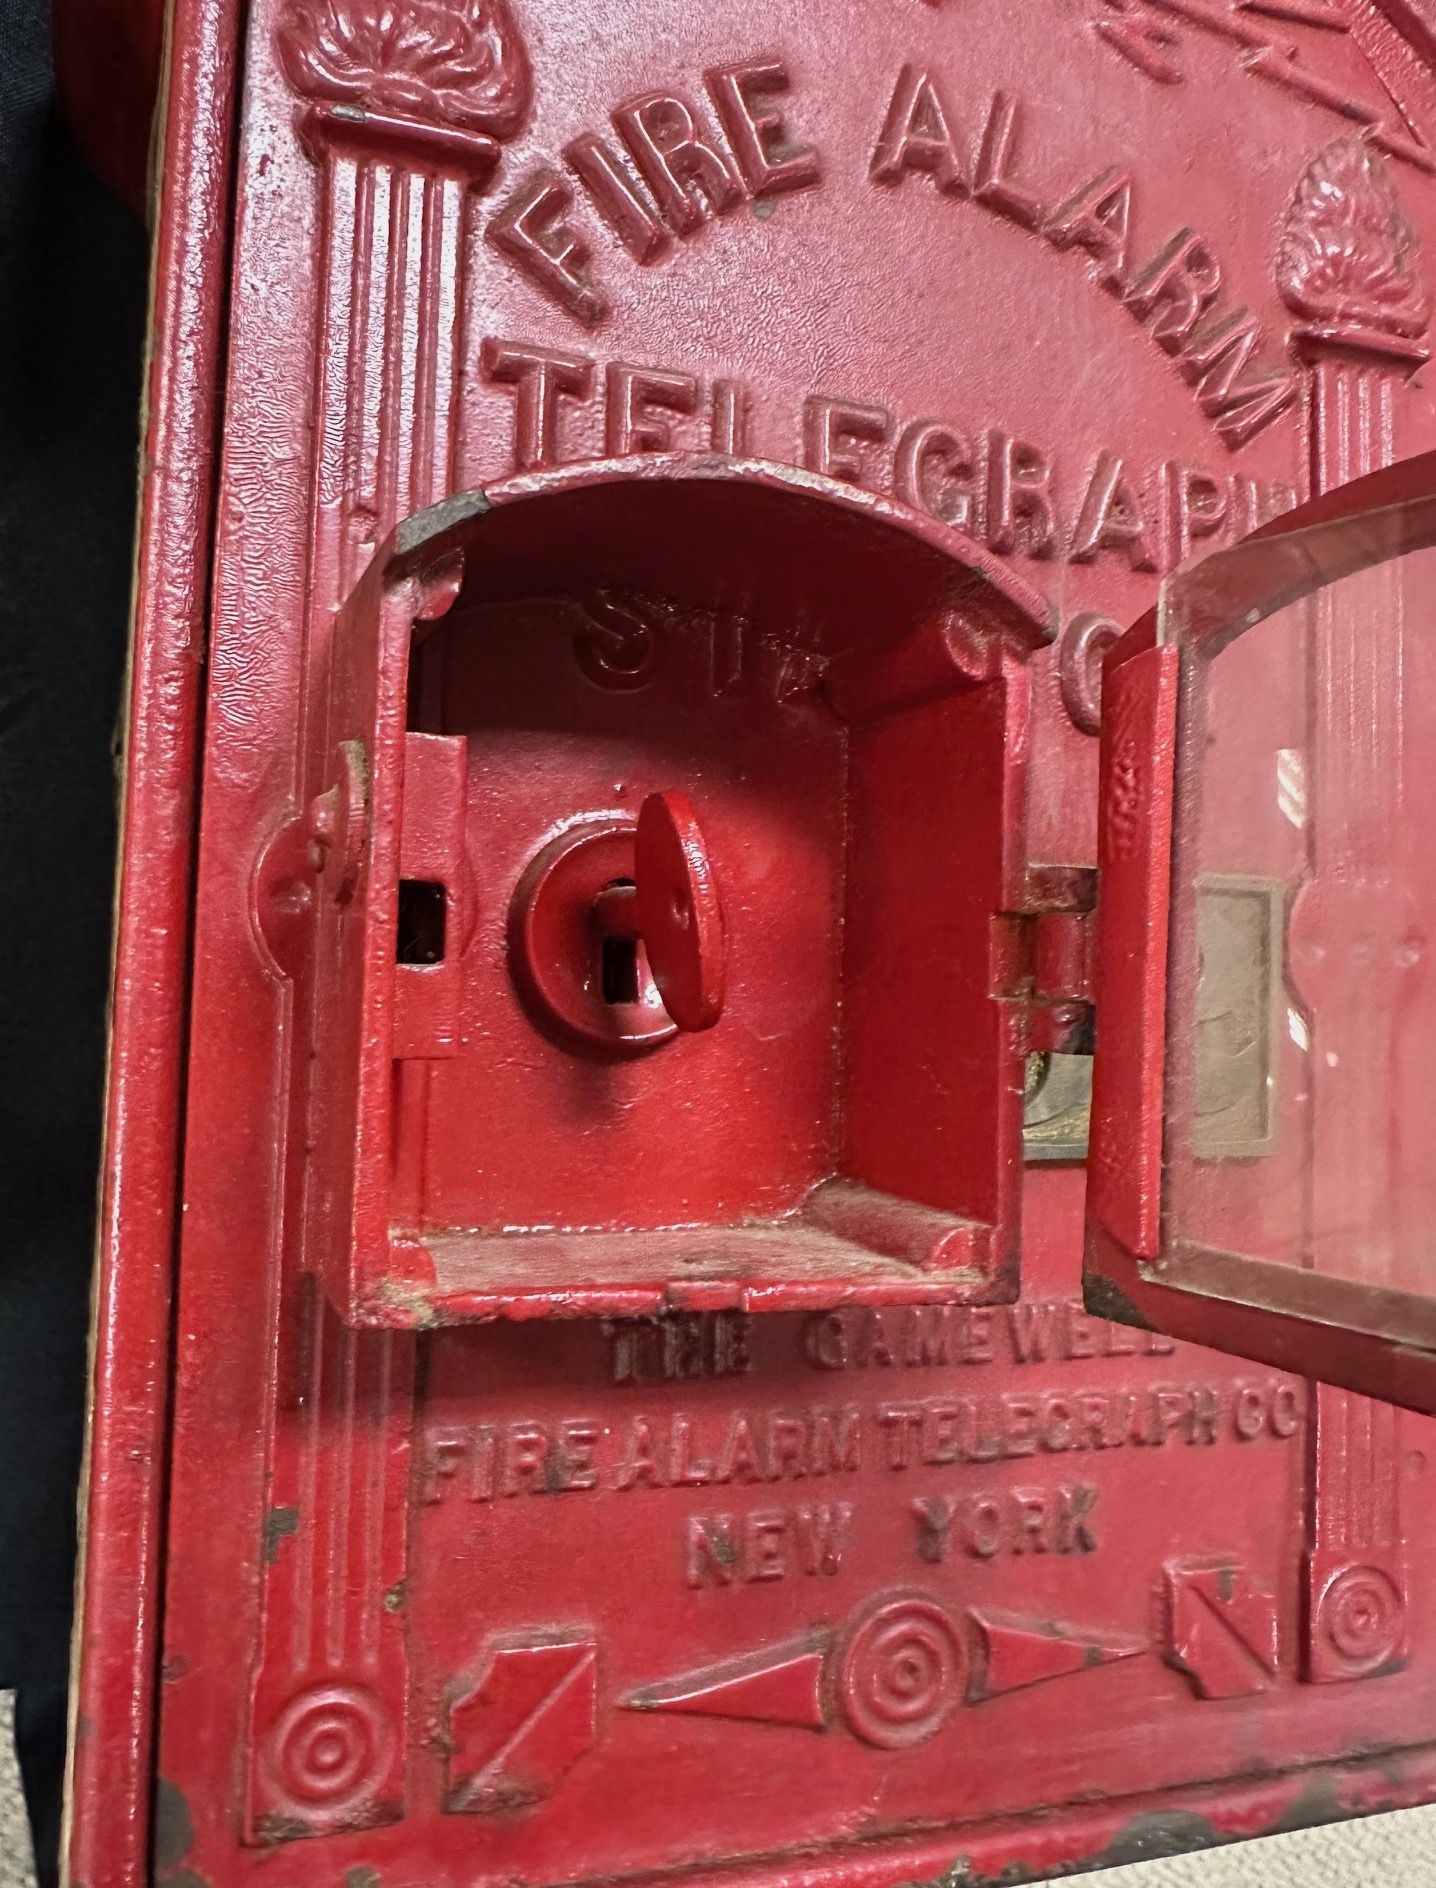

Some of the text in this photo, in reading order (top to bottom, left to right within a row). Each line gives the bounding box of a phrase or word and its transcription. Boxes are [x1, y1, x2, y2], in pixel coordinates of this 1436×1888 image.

[484, 54, 1300, 452] FIRE ALARM
[600, 1311, 756, 1387] THE
[424, 1416, 600, 1505] FIRE
[606, 1402, 862, 1493] ALARM
[876, 1380, 1218, 1472] TELEGRAPH
[684, 1483, 1098, 1590] NEW YORK
